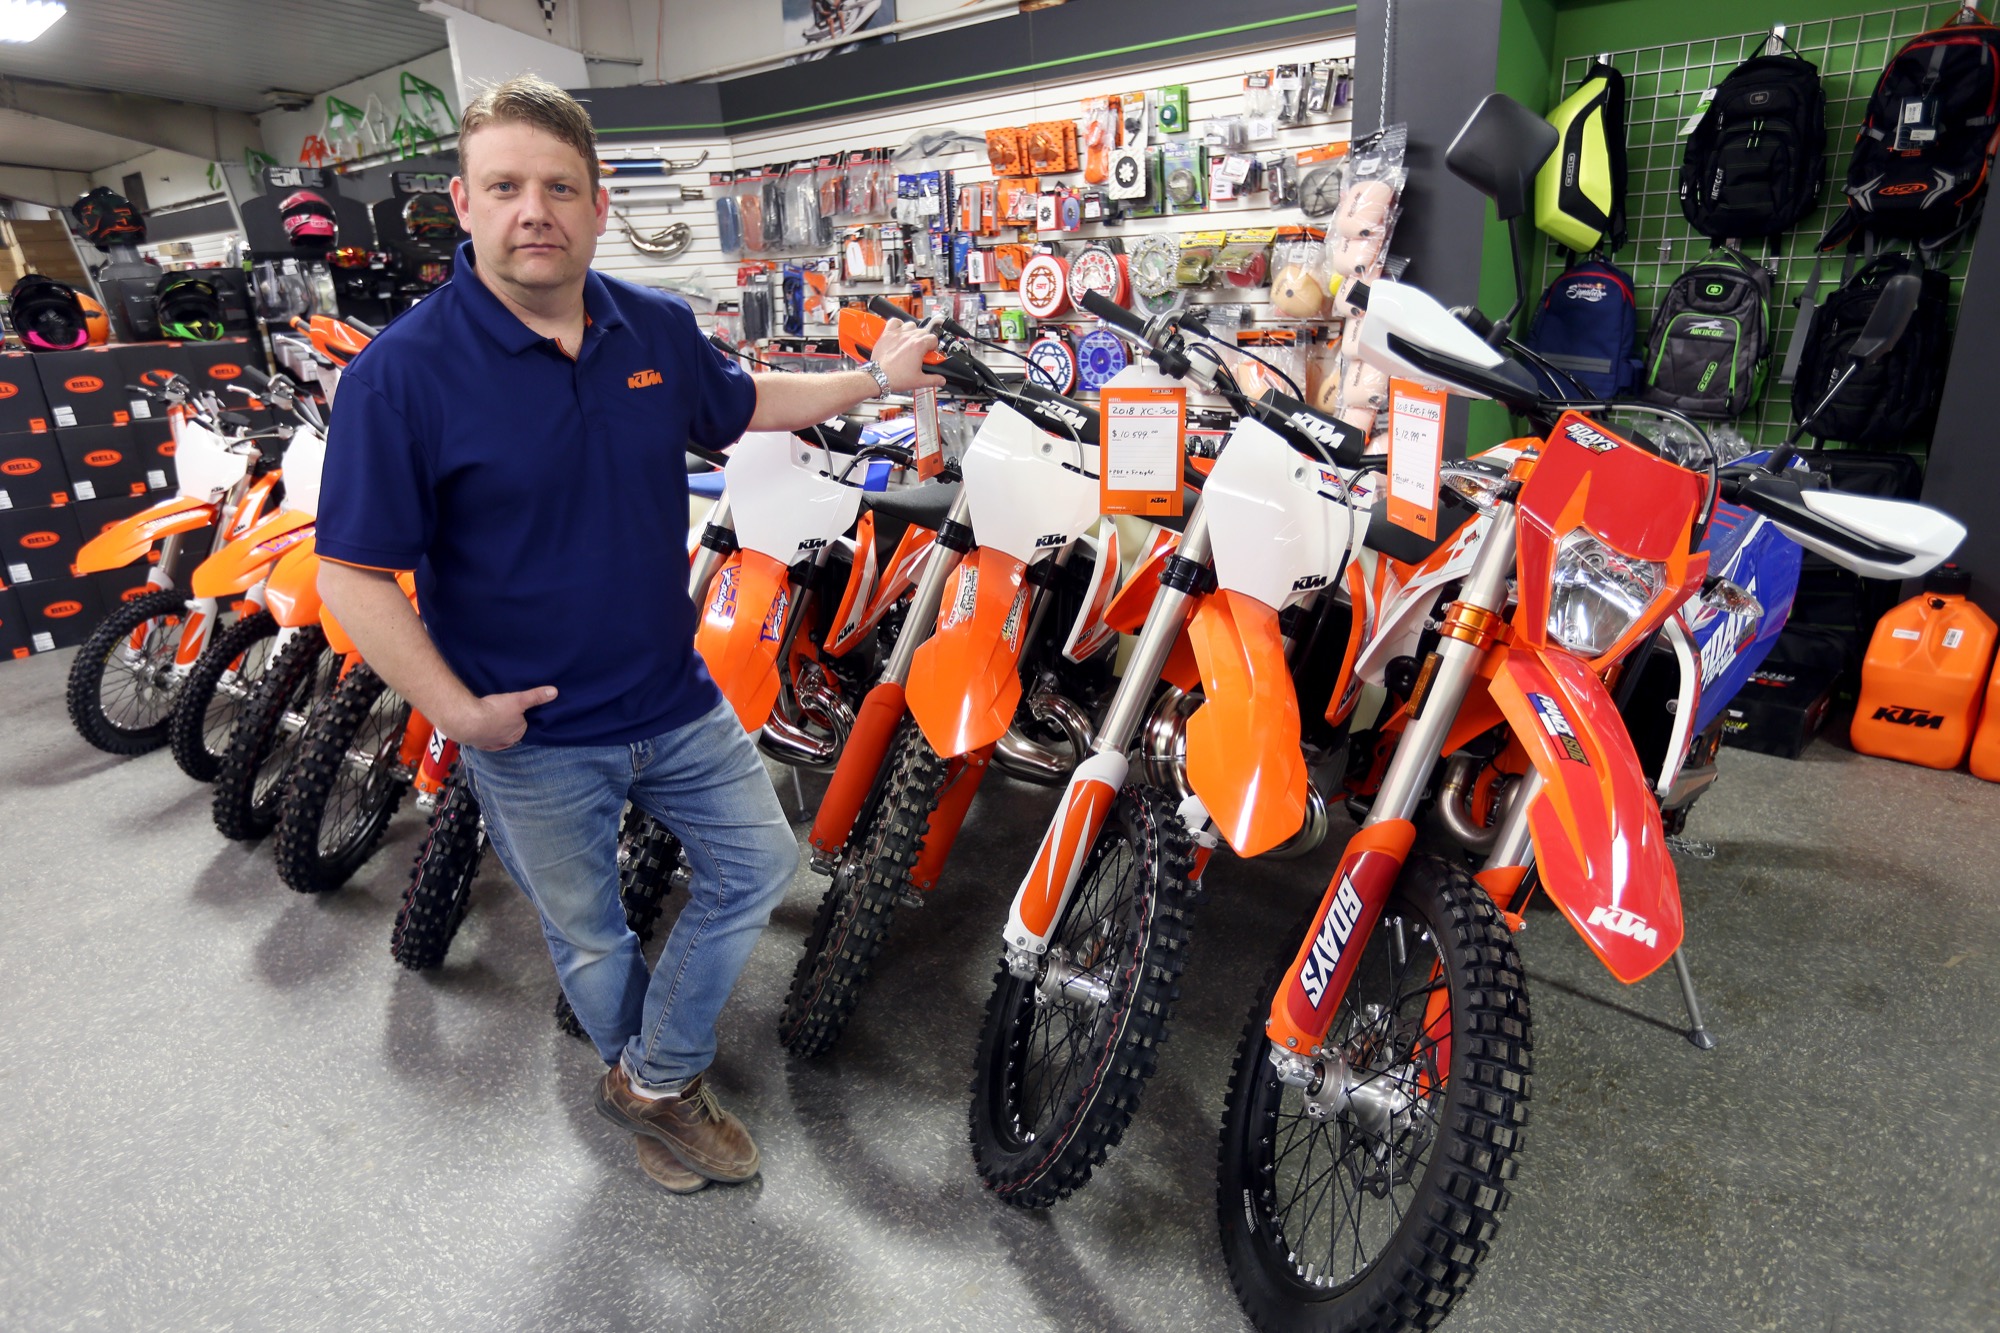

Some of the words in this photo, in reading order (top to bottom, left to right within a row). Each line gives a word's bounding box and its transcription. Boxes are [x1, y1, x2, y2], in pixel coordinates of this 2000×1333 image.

[71, 379, 97, 389] BELL
[627, 369, 663, 389] KTM
[1034, 400, 1088, 430] KTM
[1112, 406, 1135, 415] 2018
[1284, 412, 1346, 449] KTM
[90, 453, 116, 462] BELL
[7, 462, 34, 471] BELL
[27, 535, 54, 545] BELL
[798, 538, 827, 550] KTM
[1035, 533, 1067, 547] KTM
[1292, 574, 1327, 591] KTM
[50, 603, 76, 614] BELL
[837, 621, 855, 643] KTM
[1871, 705, 1945, 730] KTM
[1586, 904, 1658, 948] KTM
[1300, 874, 1364, 1009] 6DAYS
